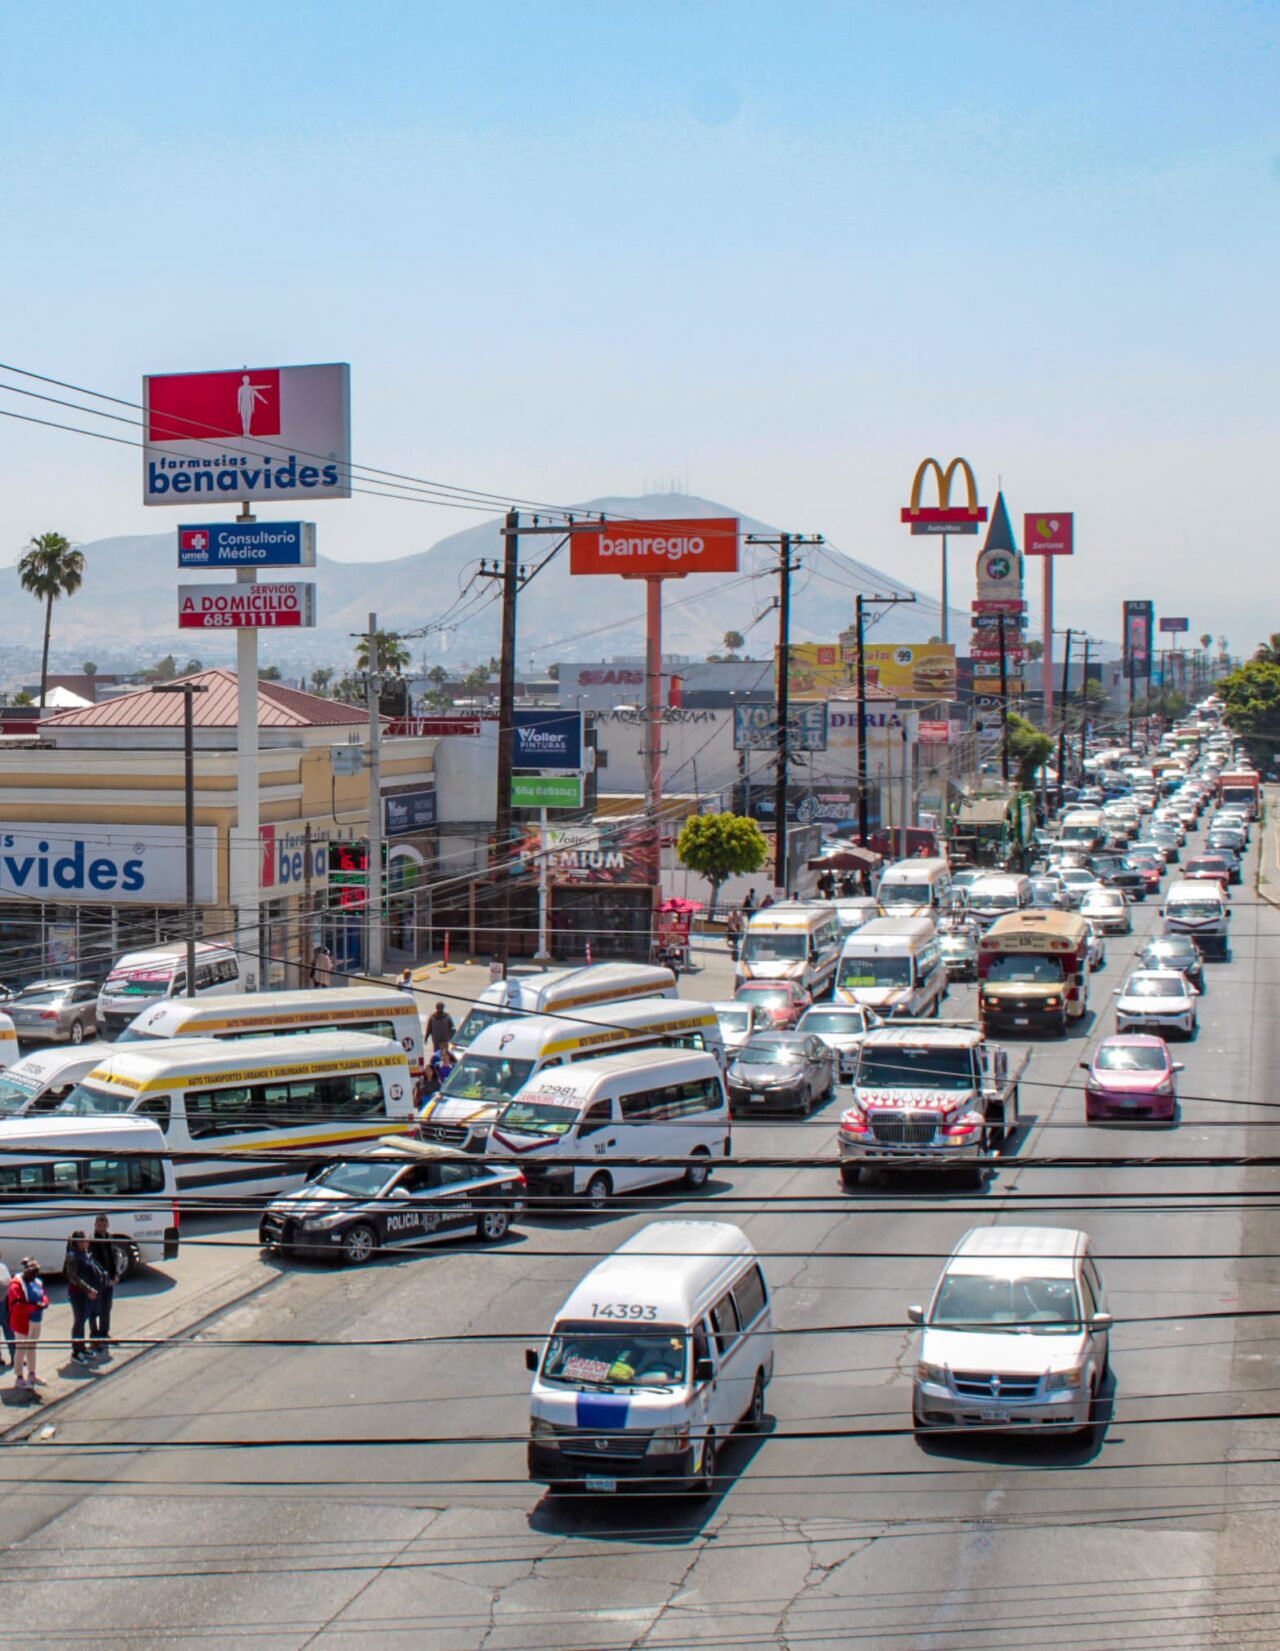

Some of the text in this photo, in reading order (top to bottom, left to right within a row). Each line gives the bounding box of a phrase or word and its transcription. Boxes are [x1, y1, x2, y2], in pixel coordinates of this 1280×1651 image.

[160, 455, 247, 470] farmacias
[148, 455, 338, 494] benavides
[218, 530, 296, 545] Consultorio
[218, 546, 266, 560] Médico
[598, 534, 705, 560] banregio
[250, 585, 296, 595] SERVICIO
[182, 594, 298, 612] A DOMICILIO
[203, 612, 277, 626] 685 1111
[577, 670, 644, 686] SEARS
[189, 1077, 203, 1086] AUTO
[204, 1073, 242, 1085] TRANSPORTES
[244, 1071, 269, 1081] URBANOS
[274, 1067, 309, 1077] SUBURBANOS
[311, 1064, 337, 1073] CORREDOR
[338, 1062, 360, 1071] TIJUANA
[591, 1303, 657, 1320] 14393
